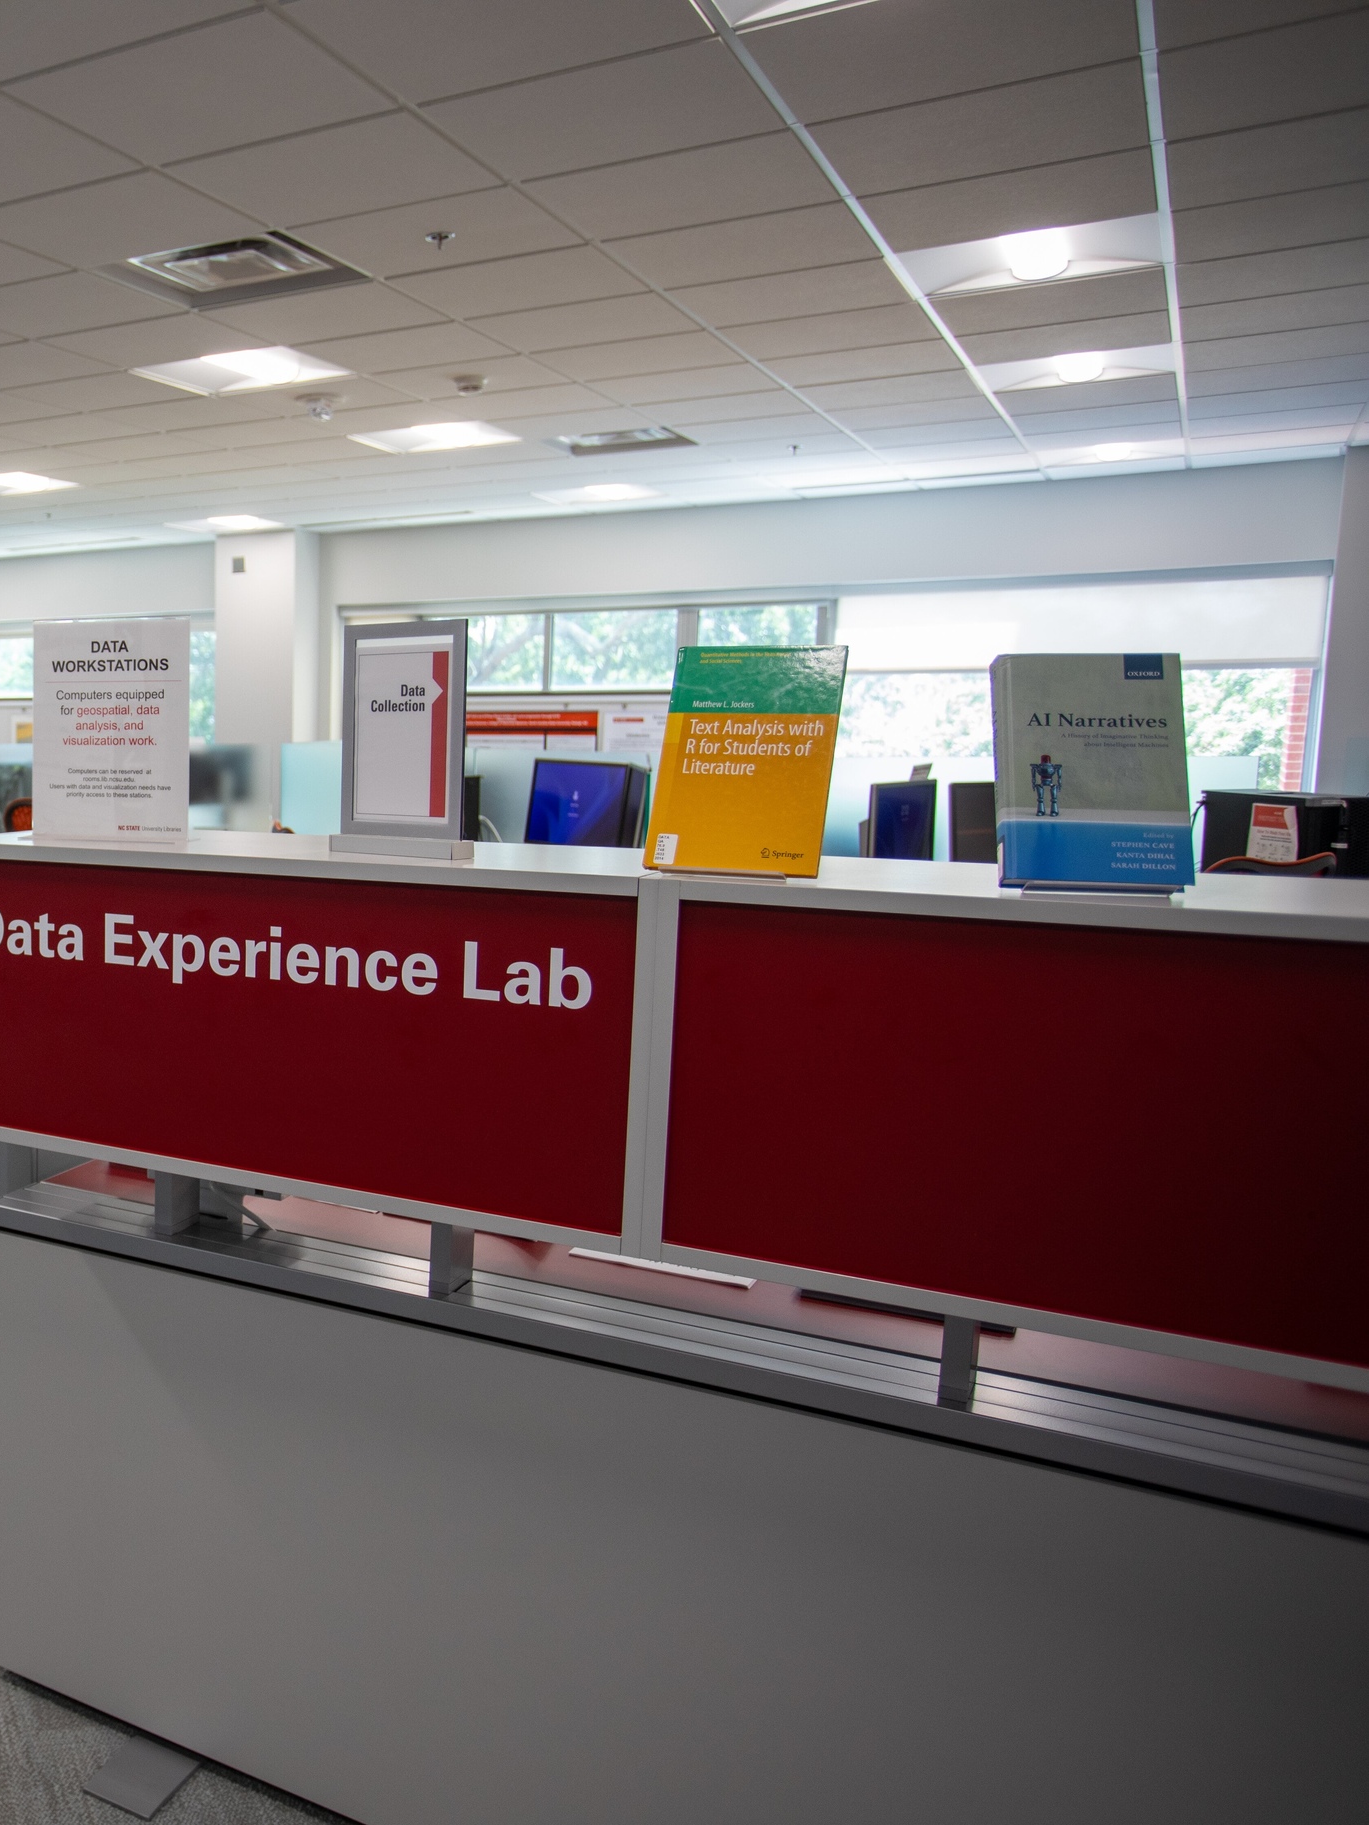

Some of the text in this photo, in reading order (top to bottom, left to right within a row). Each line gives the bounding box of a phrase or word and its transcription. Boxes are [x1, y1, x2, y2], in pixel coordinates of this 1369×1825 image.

[91, 640, 128, 653] DATA
[52, 658, 169, 672] WORKSTATIONS
[56, 689, 164, 702] Computers equipped
[400, 684, 425, 697] Data
[370, 700, 425, 712] Collection
[692, 700, 722, 708] Matthew
[730, 701, 755, 709] Jockers
[60, 705, 160, 718] for geospatial, data
[76, 720, 144, 732] analysis, and
[1027, 712, 1168, 728] AI Narratives
[690, 719, 824, 738] Text Analysis with
[62, 736, 157, 746] visualization work.
[686, 738, 813, 756] R for Students of
[682, 758, 756, 776] Literature
[772, 850, 804, 860] Springer
[104, 912, 438, 995] Experience
[462, 941, 592, 1010] Lab
